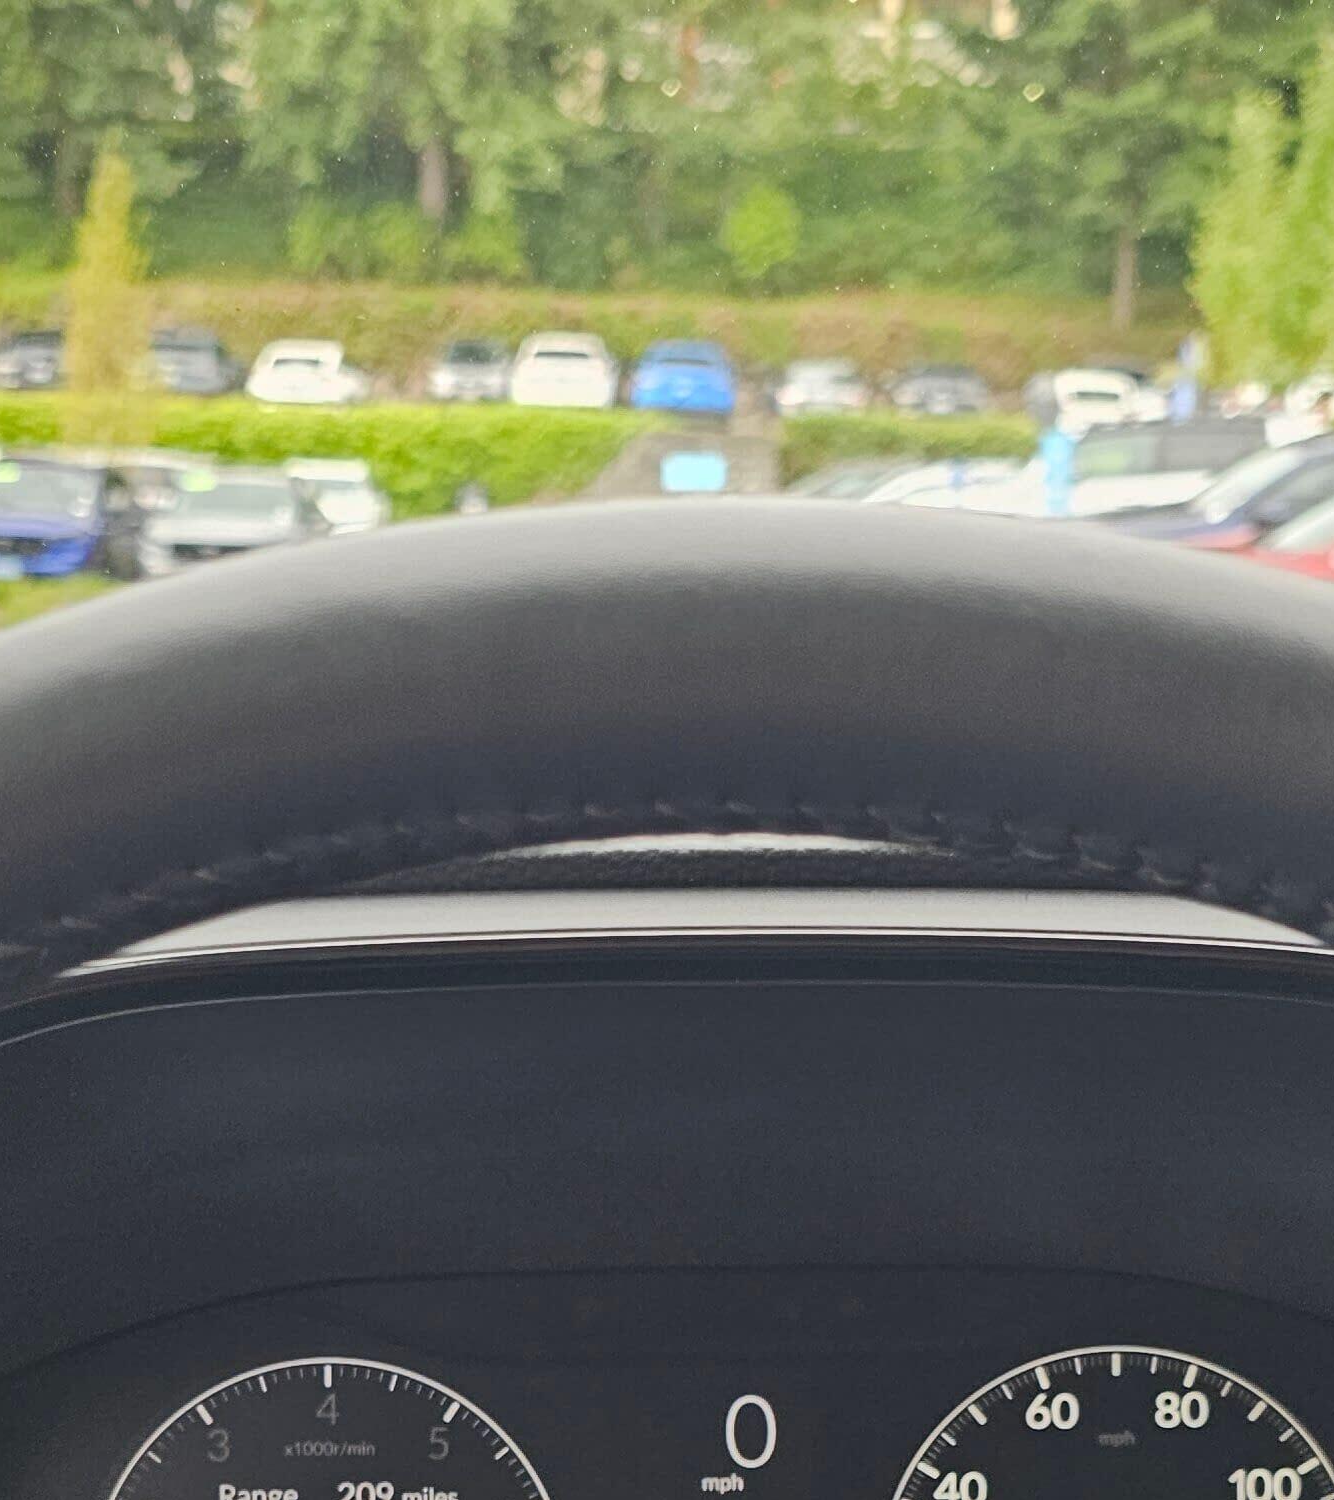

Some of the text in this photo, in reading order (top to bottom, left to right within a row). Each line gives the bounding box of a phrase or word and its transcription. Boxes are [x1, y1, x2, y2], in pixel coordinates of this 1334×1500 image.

[315, 1392, 340, 1427] 4
[1025, 1392, 1080, 1431] 60
[1154, 1391, 1210, 1430] 80
[207, 1428, 231, 1464] 3
[429, 1426, 450, 1462] 5
[725, 1394, 777, 1469] 0
[1098, 1428, 1136, 1448] mph
[283, 1441, 377, 1460] x1000r/min
[700, 1472, 745, 1496] mph
